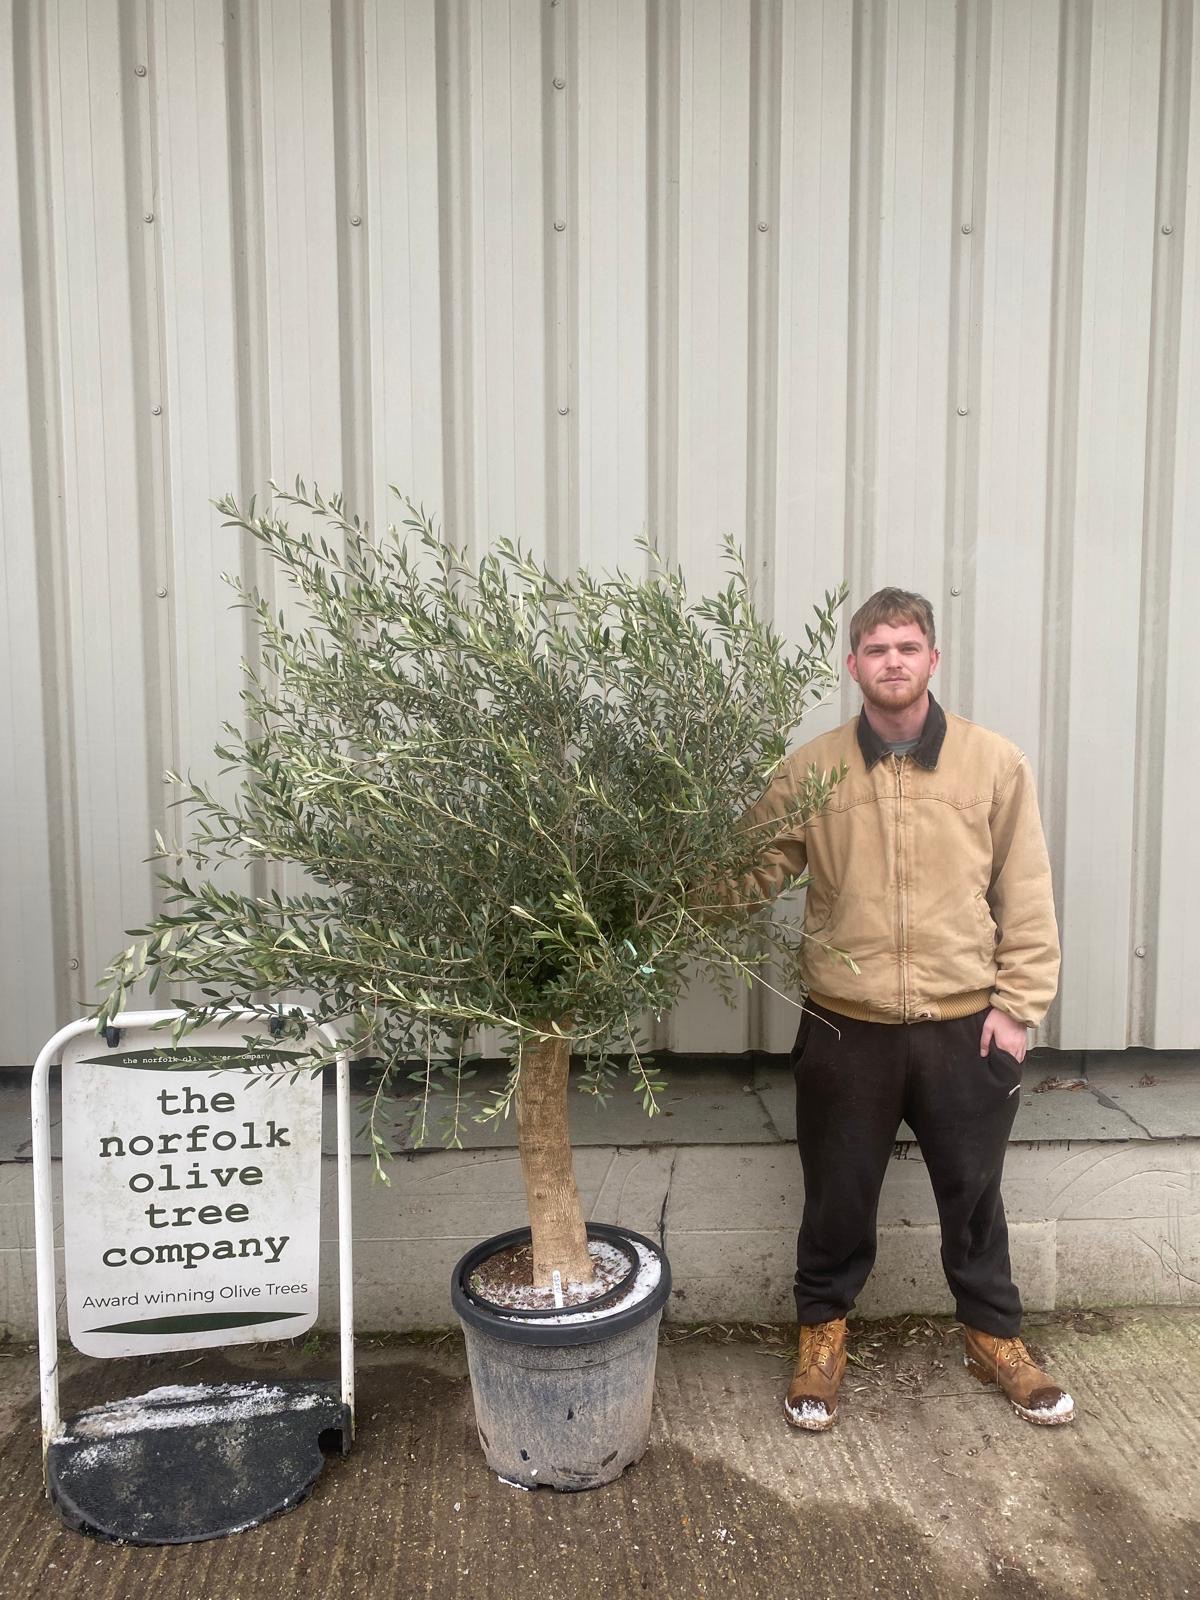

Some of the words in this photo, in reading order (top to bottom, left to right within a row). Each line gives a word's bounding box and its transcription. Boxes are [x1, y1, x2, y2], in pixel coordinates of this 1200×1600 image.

[142, 1056, 178, 1064] norfolk
[156, 1086, 235, 1116] the
[99, 1120, 291, 1158] norfolk
[128, 1162, 263, 1193] olive
[144, 1203, 249, 1229] tree
[102, 1236, 290, 1270] company
[82, 1292, 139, 1309] Award
[144, 1290, 214, 1304] winning
[219, 1285, 261, 1299] Olive
[266, 1283, 308, 1295] Trees
